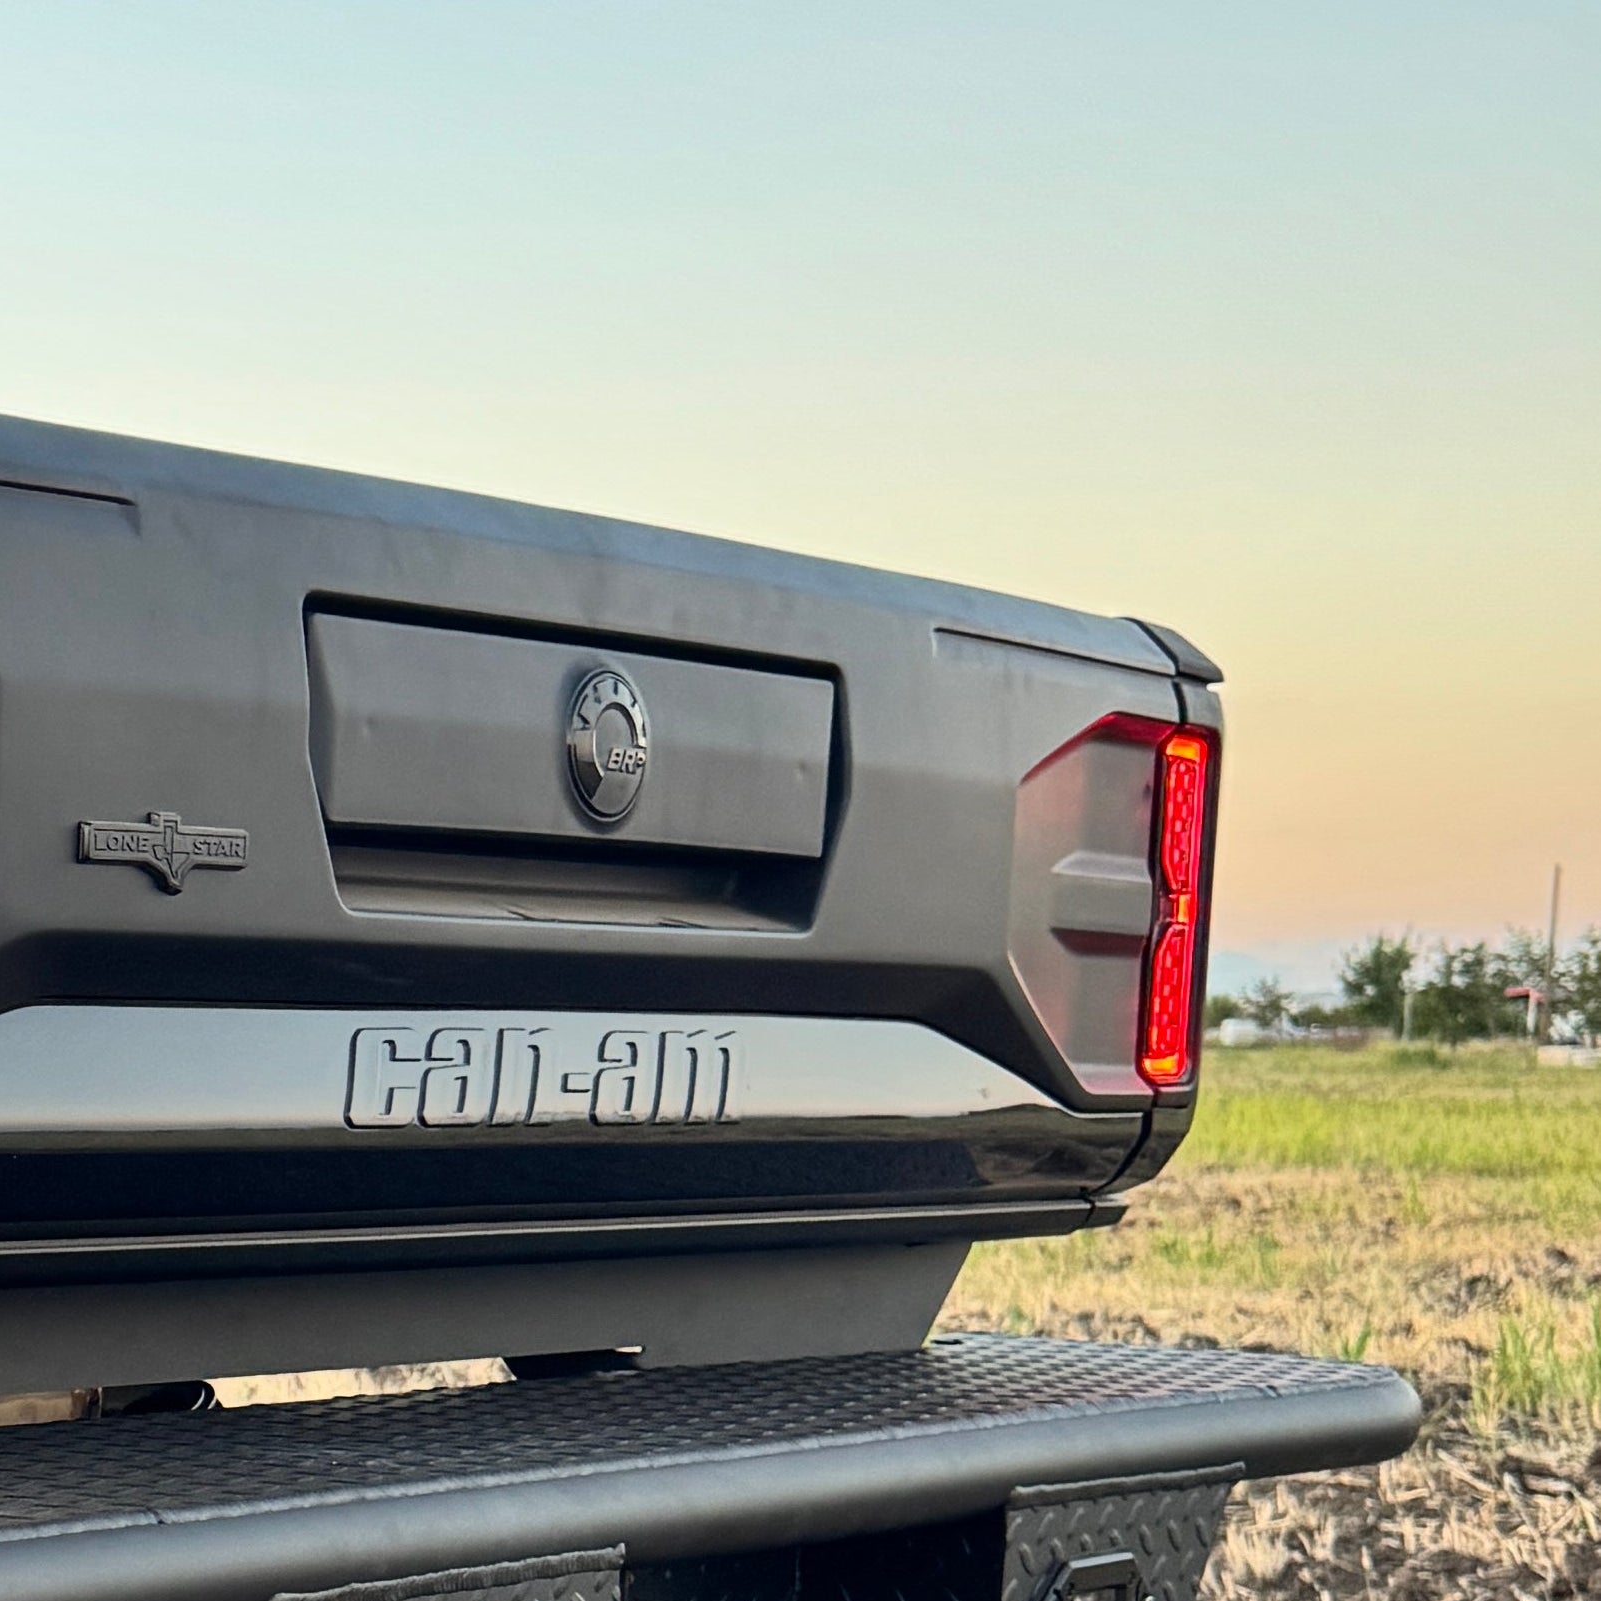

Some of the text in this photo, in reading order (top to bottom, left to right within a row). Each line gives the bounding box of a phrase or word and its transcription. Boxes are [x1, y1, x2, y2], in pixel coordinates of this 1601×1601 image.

[607, 747, 647, 774] BRP
[93, 832, 242, 859] LONE STAR
[343, 1026, 743, 1129] can-am
